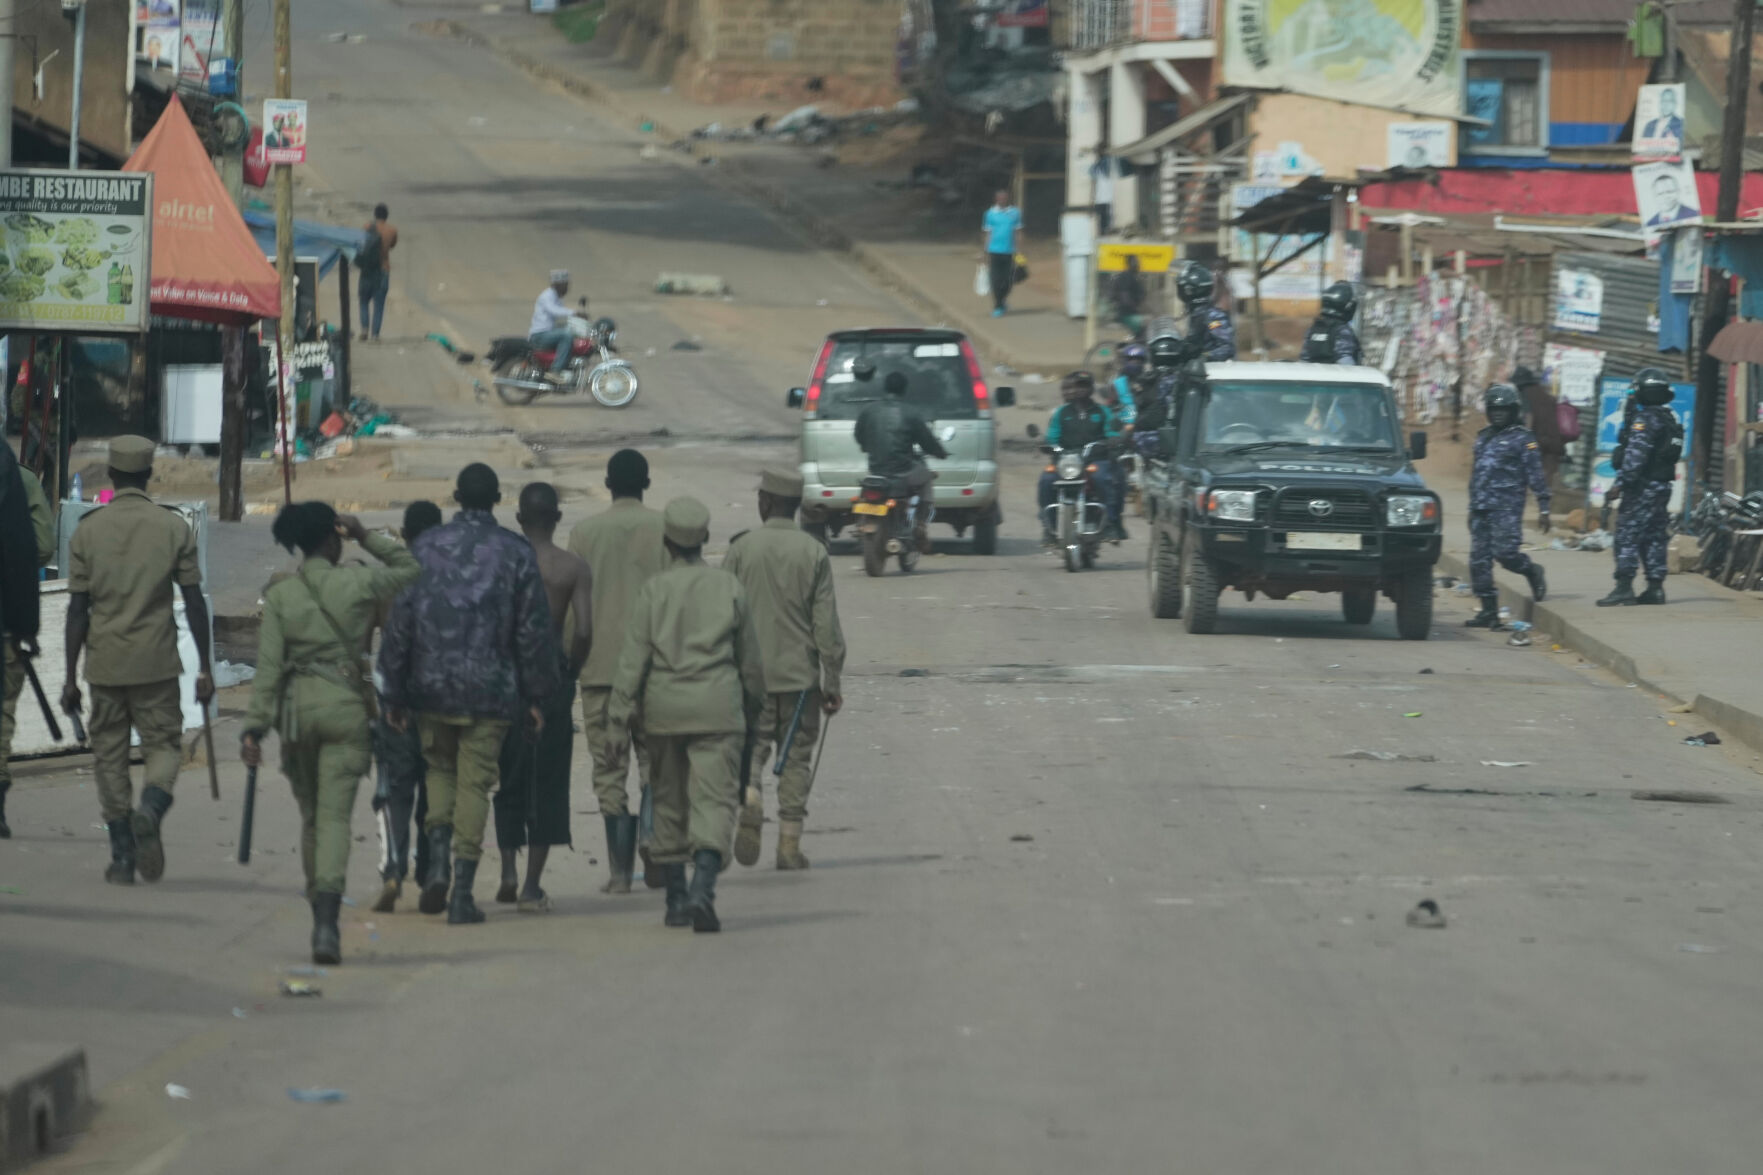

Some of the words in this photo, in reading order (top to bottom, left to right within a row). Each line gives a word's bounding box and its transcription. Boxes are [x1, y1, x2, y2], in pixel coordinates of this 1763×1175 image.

[33, 176, 142, 201] RESTAURANT
[15, 198, 47, 212] quality
[51, 199, 58, 210] is
[61, 202, 77, 210] our
[80, 201, 118, 214] priority
[159, 198, 214, 222] airtel
